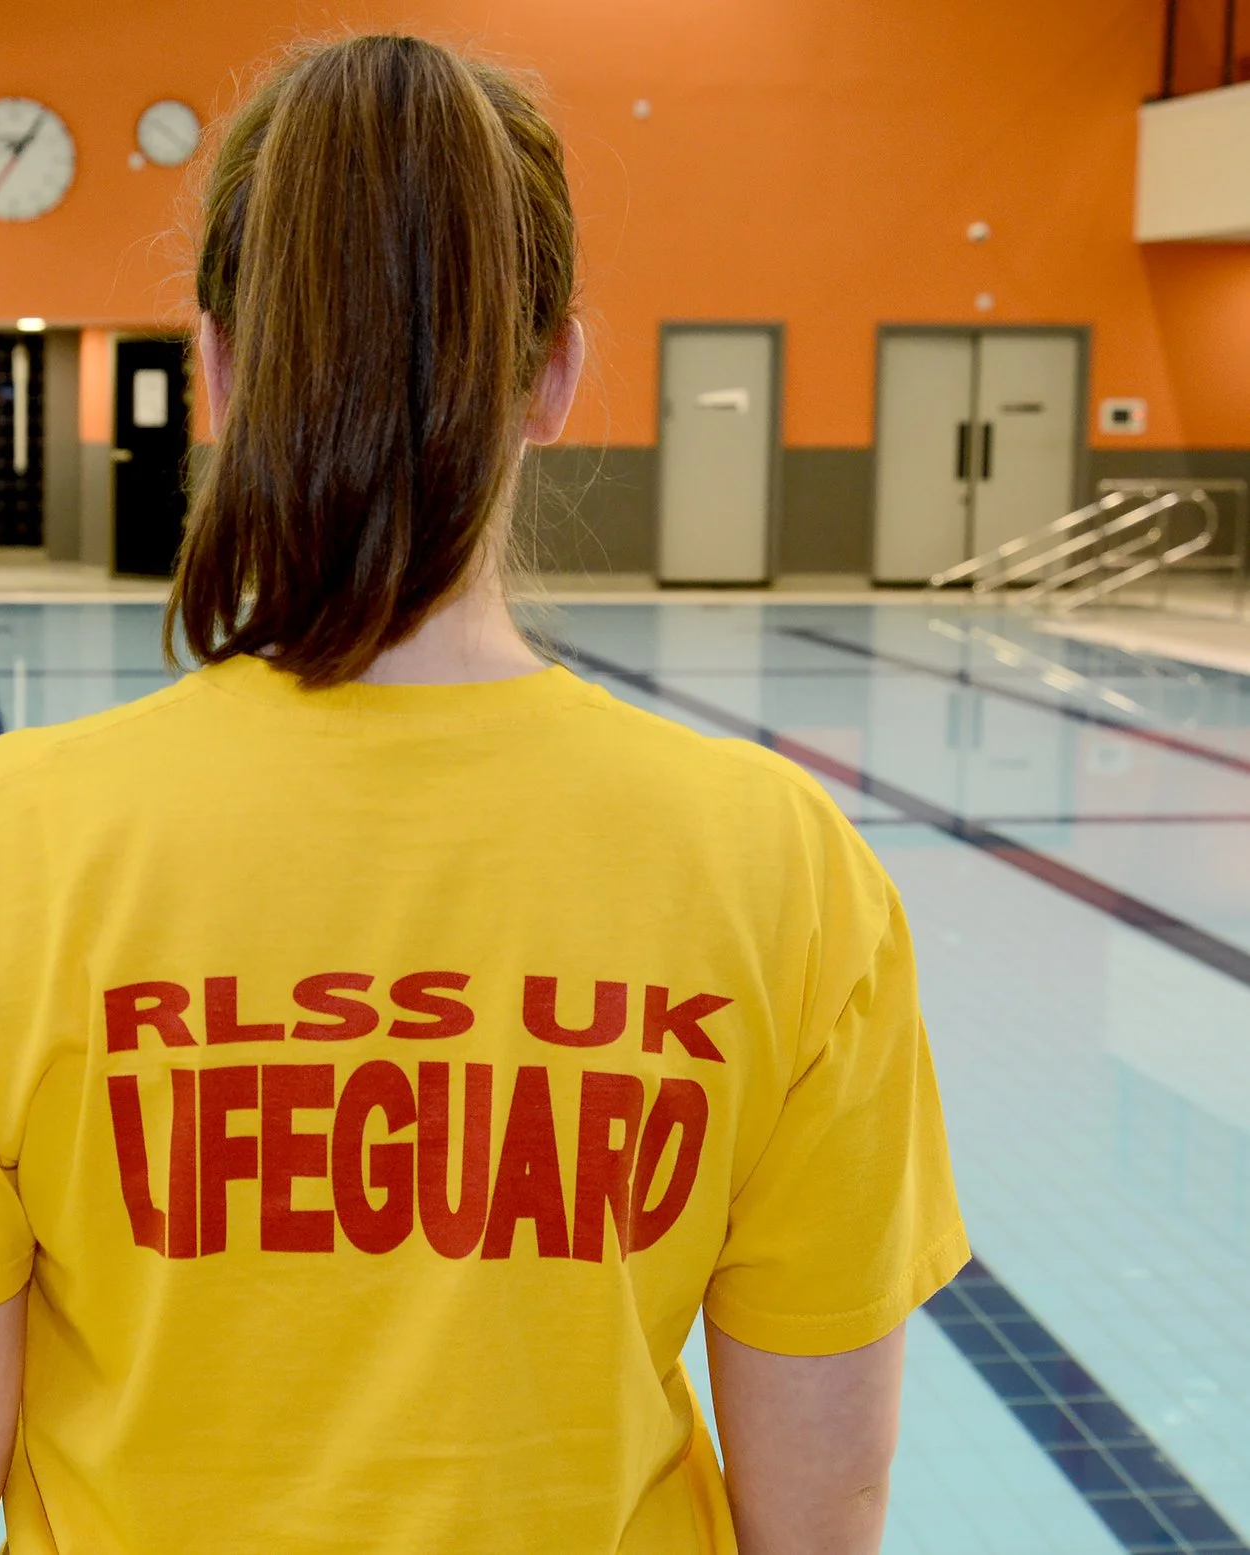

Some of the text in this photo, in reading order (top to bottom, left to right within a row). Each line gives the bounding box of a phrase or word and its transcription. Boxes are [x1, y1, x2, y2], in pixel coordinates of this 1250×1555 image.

[104, 971, 735, 1064] RLSS UK
[107, 1060, 710, 1263] LIFEGUARD
